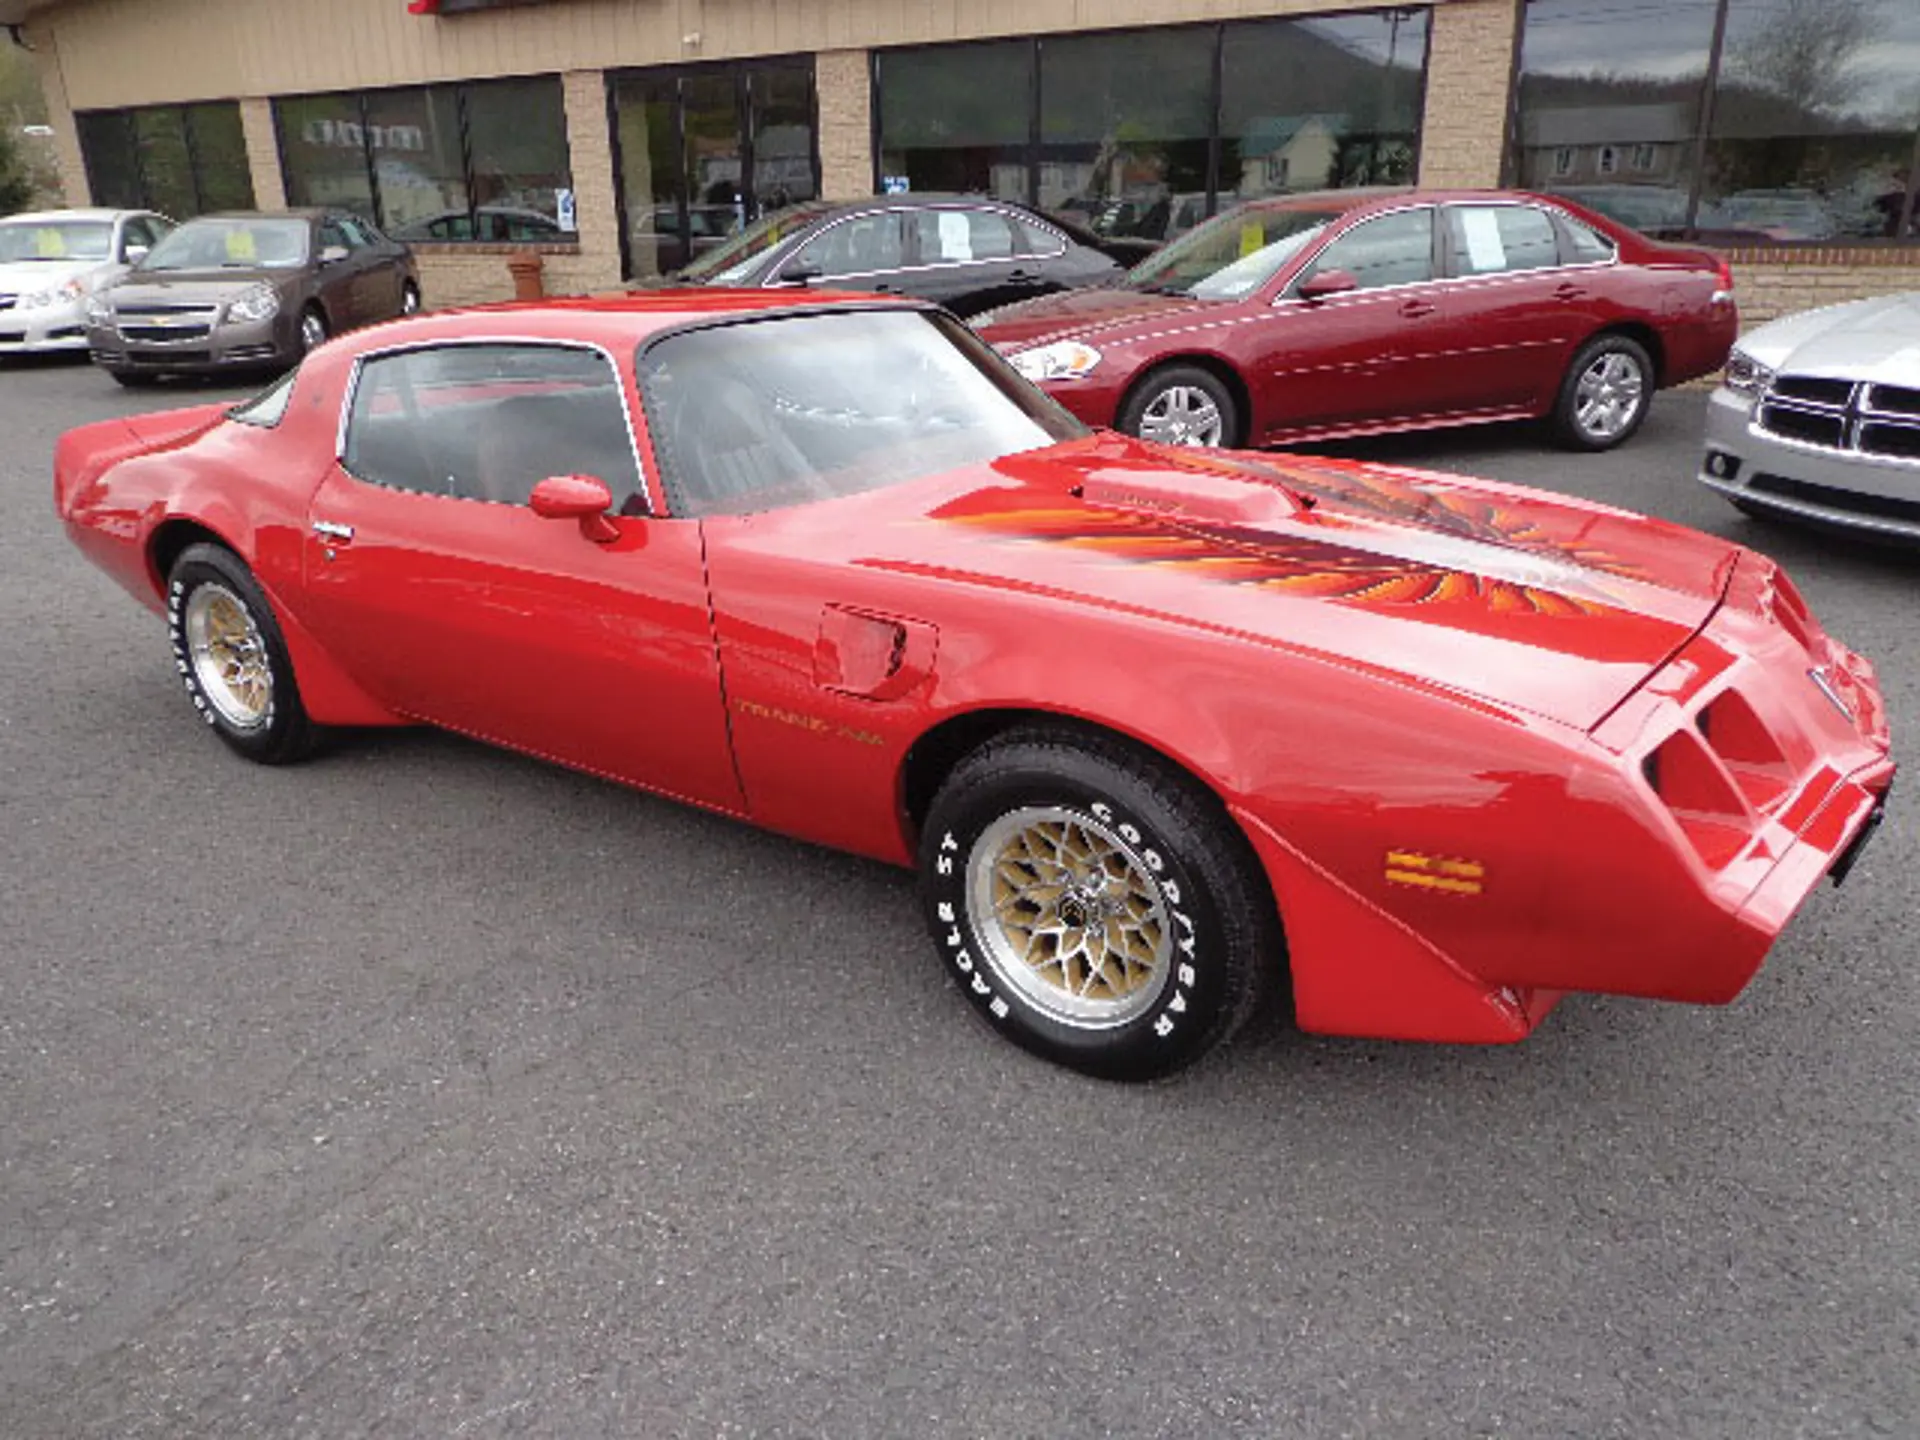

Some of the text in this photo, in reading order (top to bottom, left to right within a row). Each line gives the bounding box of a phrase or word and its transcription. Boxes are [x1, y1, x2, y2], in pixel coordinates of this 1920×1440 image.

[937, 831, 1010, 1018] EAGLE ST
[1091, 802, 1196, 1037] GOODYEAR
